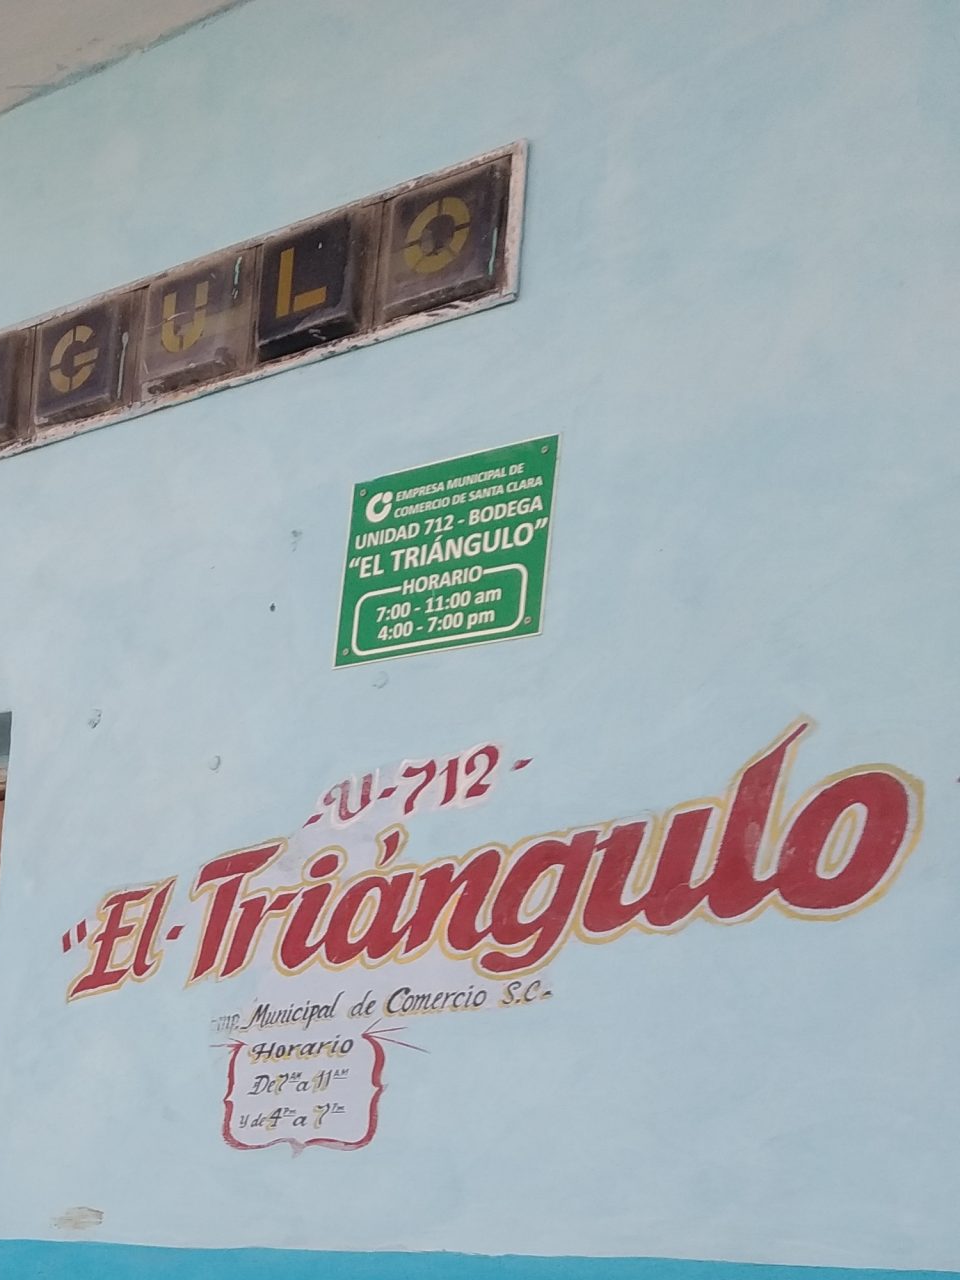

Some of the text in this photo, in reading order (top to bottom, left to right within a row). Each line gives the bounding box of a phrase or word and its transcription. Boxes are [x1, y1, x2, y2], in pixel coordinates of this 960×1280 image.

[393, 475, 544, 518] COMERCIO DE SANTA CLARA
[396, 462, 525, 502] EMPRESA MUNICIPAL DE
[354, 522, 421, 550] UNIDAD
[424, 514, 455, 535] 712
[468, 495, 544, 526] BODEGA
[401, 565, 484, 596] HORARIO
[376, 602, 412, 623] 7:00
[424, 592, 472, 614] 11:00
[474, 587, 502, 603] am
[377, 621, 413, 641] 4:00
[427, 612, 464, 633] 7:00
[466, 609, 496, 629] pm
[186, 716, 917, 986] Triángulo
[241, 990, 346, 1031] Municipal
[350, 991, 377, 1018] de
[385, 985, 488, 1015] Comercio
[252, 1034, 355, 1062] Horario
[247, 1074, 276, 1096] De
[296, 1079, 311, 1092] a
[250, 1113, 267, 1128] de
[292, 1115, 309, 1127] a
